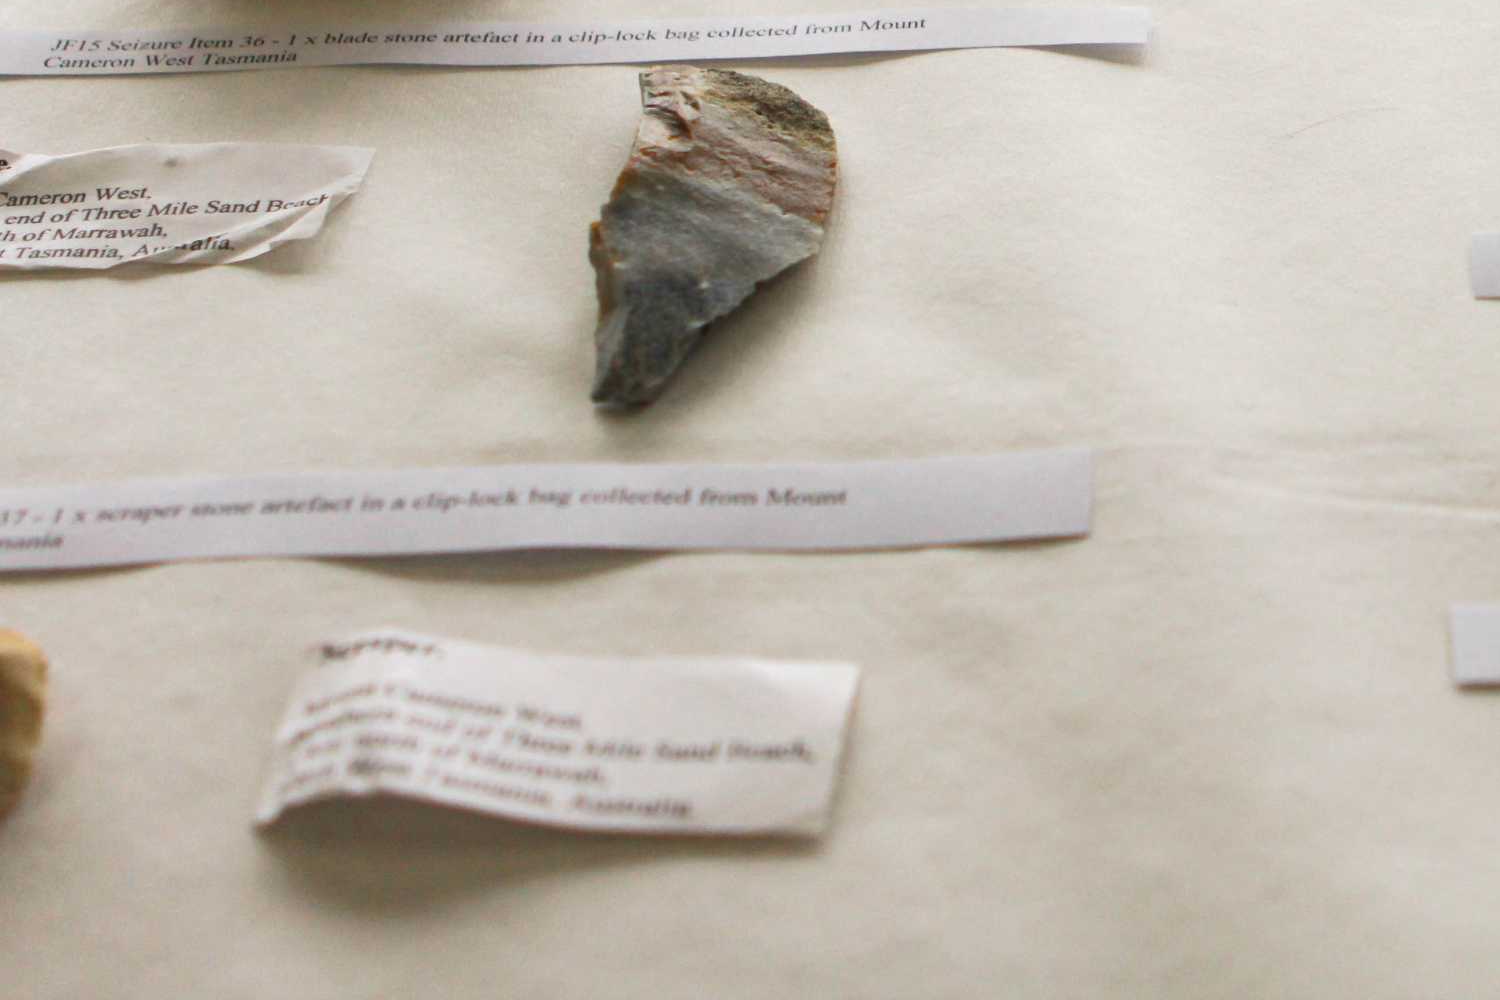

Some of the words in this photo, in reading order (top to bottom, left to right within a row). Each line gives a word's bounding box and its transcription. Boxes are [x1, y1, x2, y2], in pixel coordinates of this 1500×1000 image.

[50, 39, 103, 52] JF15
[108, 39, 184, 51] Seizure
[190, 37, 233, 49] Item
[240, 36, 265, 48] 36
[324, 32, 377, 45] blade
[384, 32, 437, 44] stone
[443, 31, 519, 44] artefact
[526, 30, 544, 43] in
[568, 29, 657, 45] clip-lock
[665, 27, 700, 42] bag
[707, 24, 797, 39] collected
[805, 22, 852, 36] from
[859, 18, 927, 32] Mount
[43, 56, 135, 68] Cameron
[146, 53, 194, 66] West
[204, 50, 298, 65] Tasmania
[4, 210, 43, 226] end
[50, 208, 79, 222] of
[82, 207, 141, 222] Three
[148, 201, 198, 216] Mile
[204, 199, 258, 214] Sand
[22, 228, 50, 242] of
[15, 244, 124, 261] Tasmania,
[131, 238, 235, 260] Aalia.
